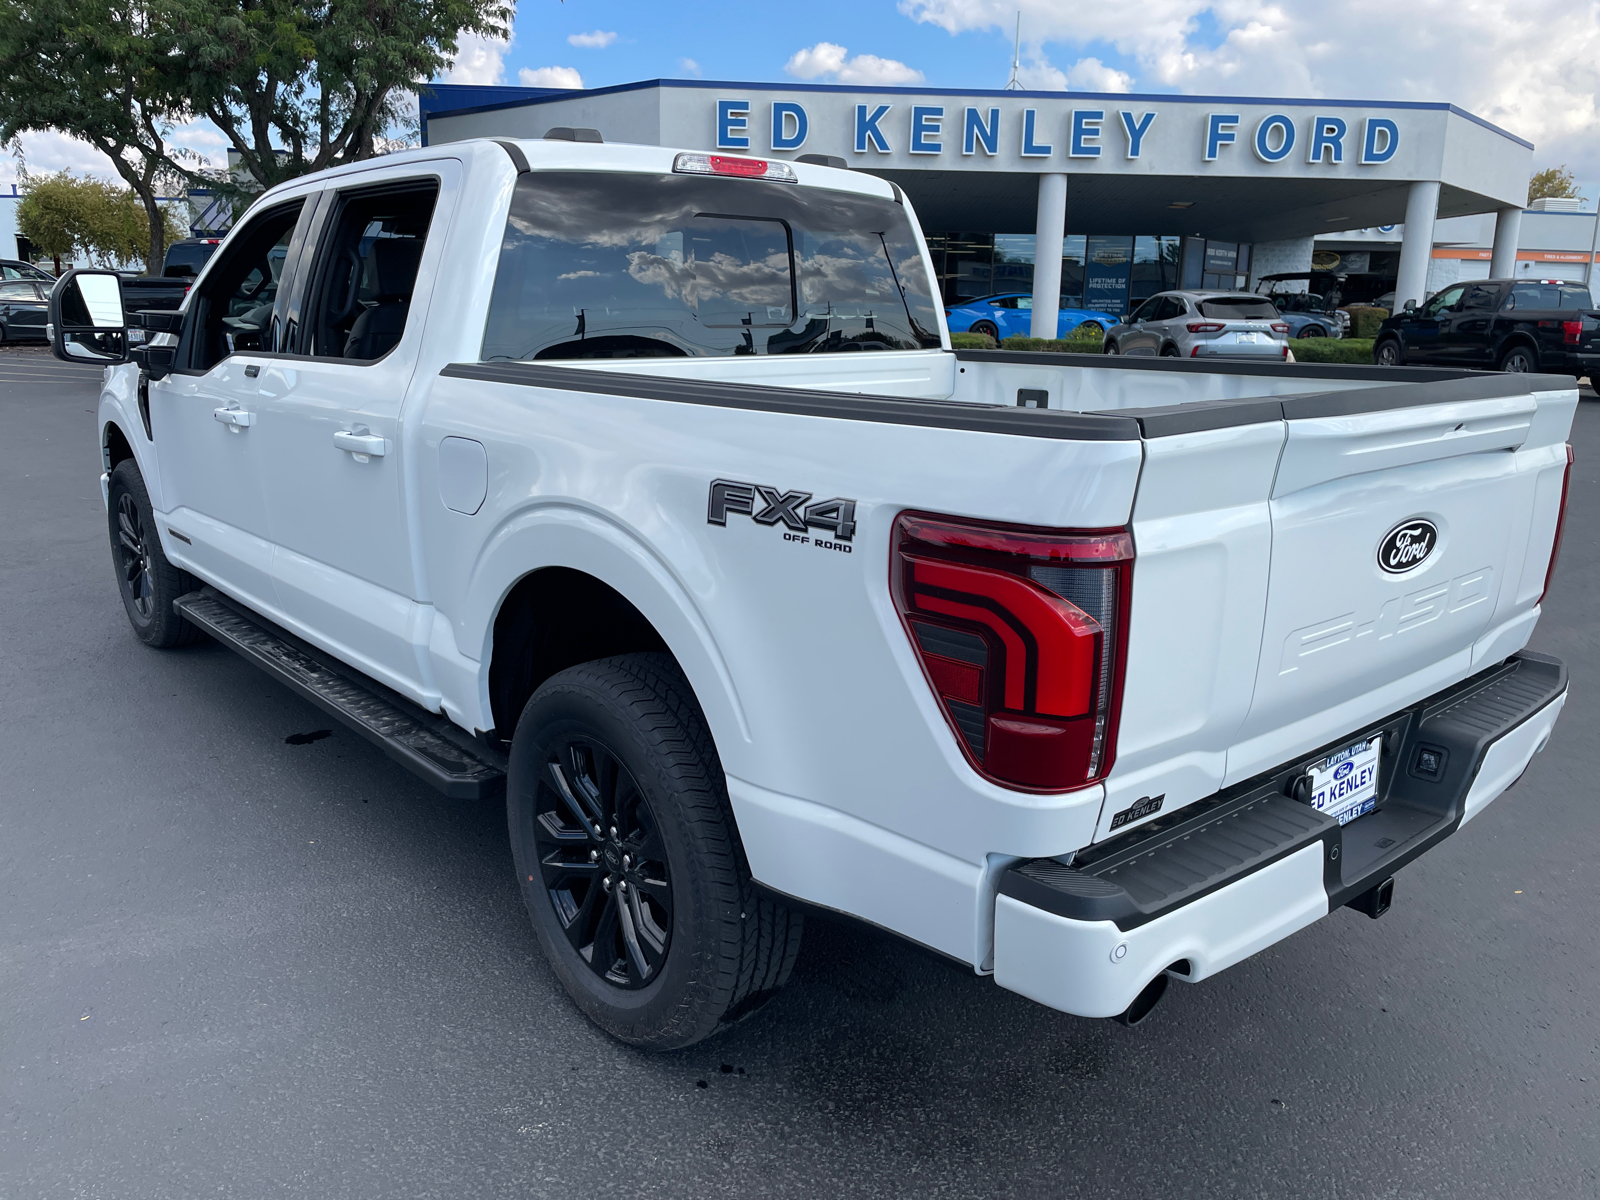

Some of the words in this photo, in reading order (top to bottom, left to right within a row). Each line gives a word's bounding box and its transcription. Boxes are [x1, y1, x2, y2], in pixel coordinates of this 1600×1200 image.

[716, 99, 809, 151] ED
[853, 103, 1159, 160] KENLEY
[1202, 112, 1399, 165] FORD
[707, 477, 857, 543] FX4
[783, 532, 810, 544] OFF
[814, 538, 852, 554] ROAD
[1279, 565, 1494, 676] F-150
[1351, 740, 1367, 755] UTAH
[1329, 764, 1375, 804] KENLEY
[1112, 814, 1125, 828] ED
[1127, 798, 1164, 822] KENLEY
[1336, 803, 1362, 824] ENLEY
